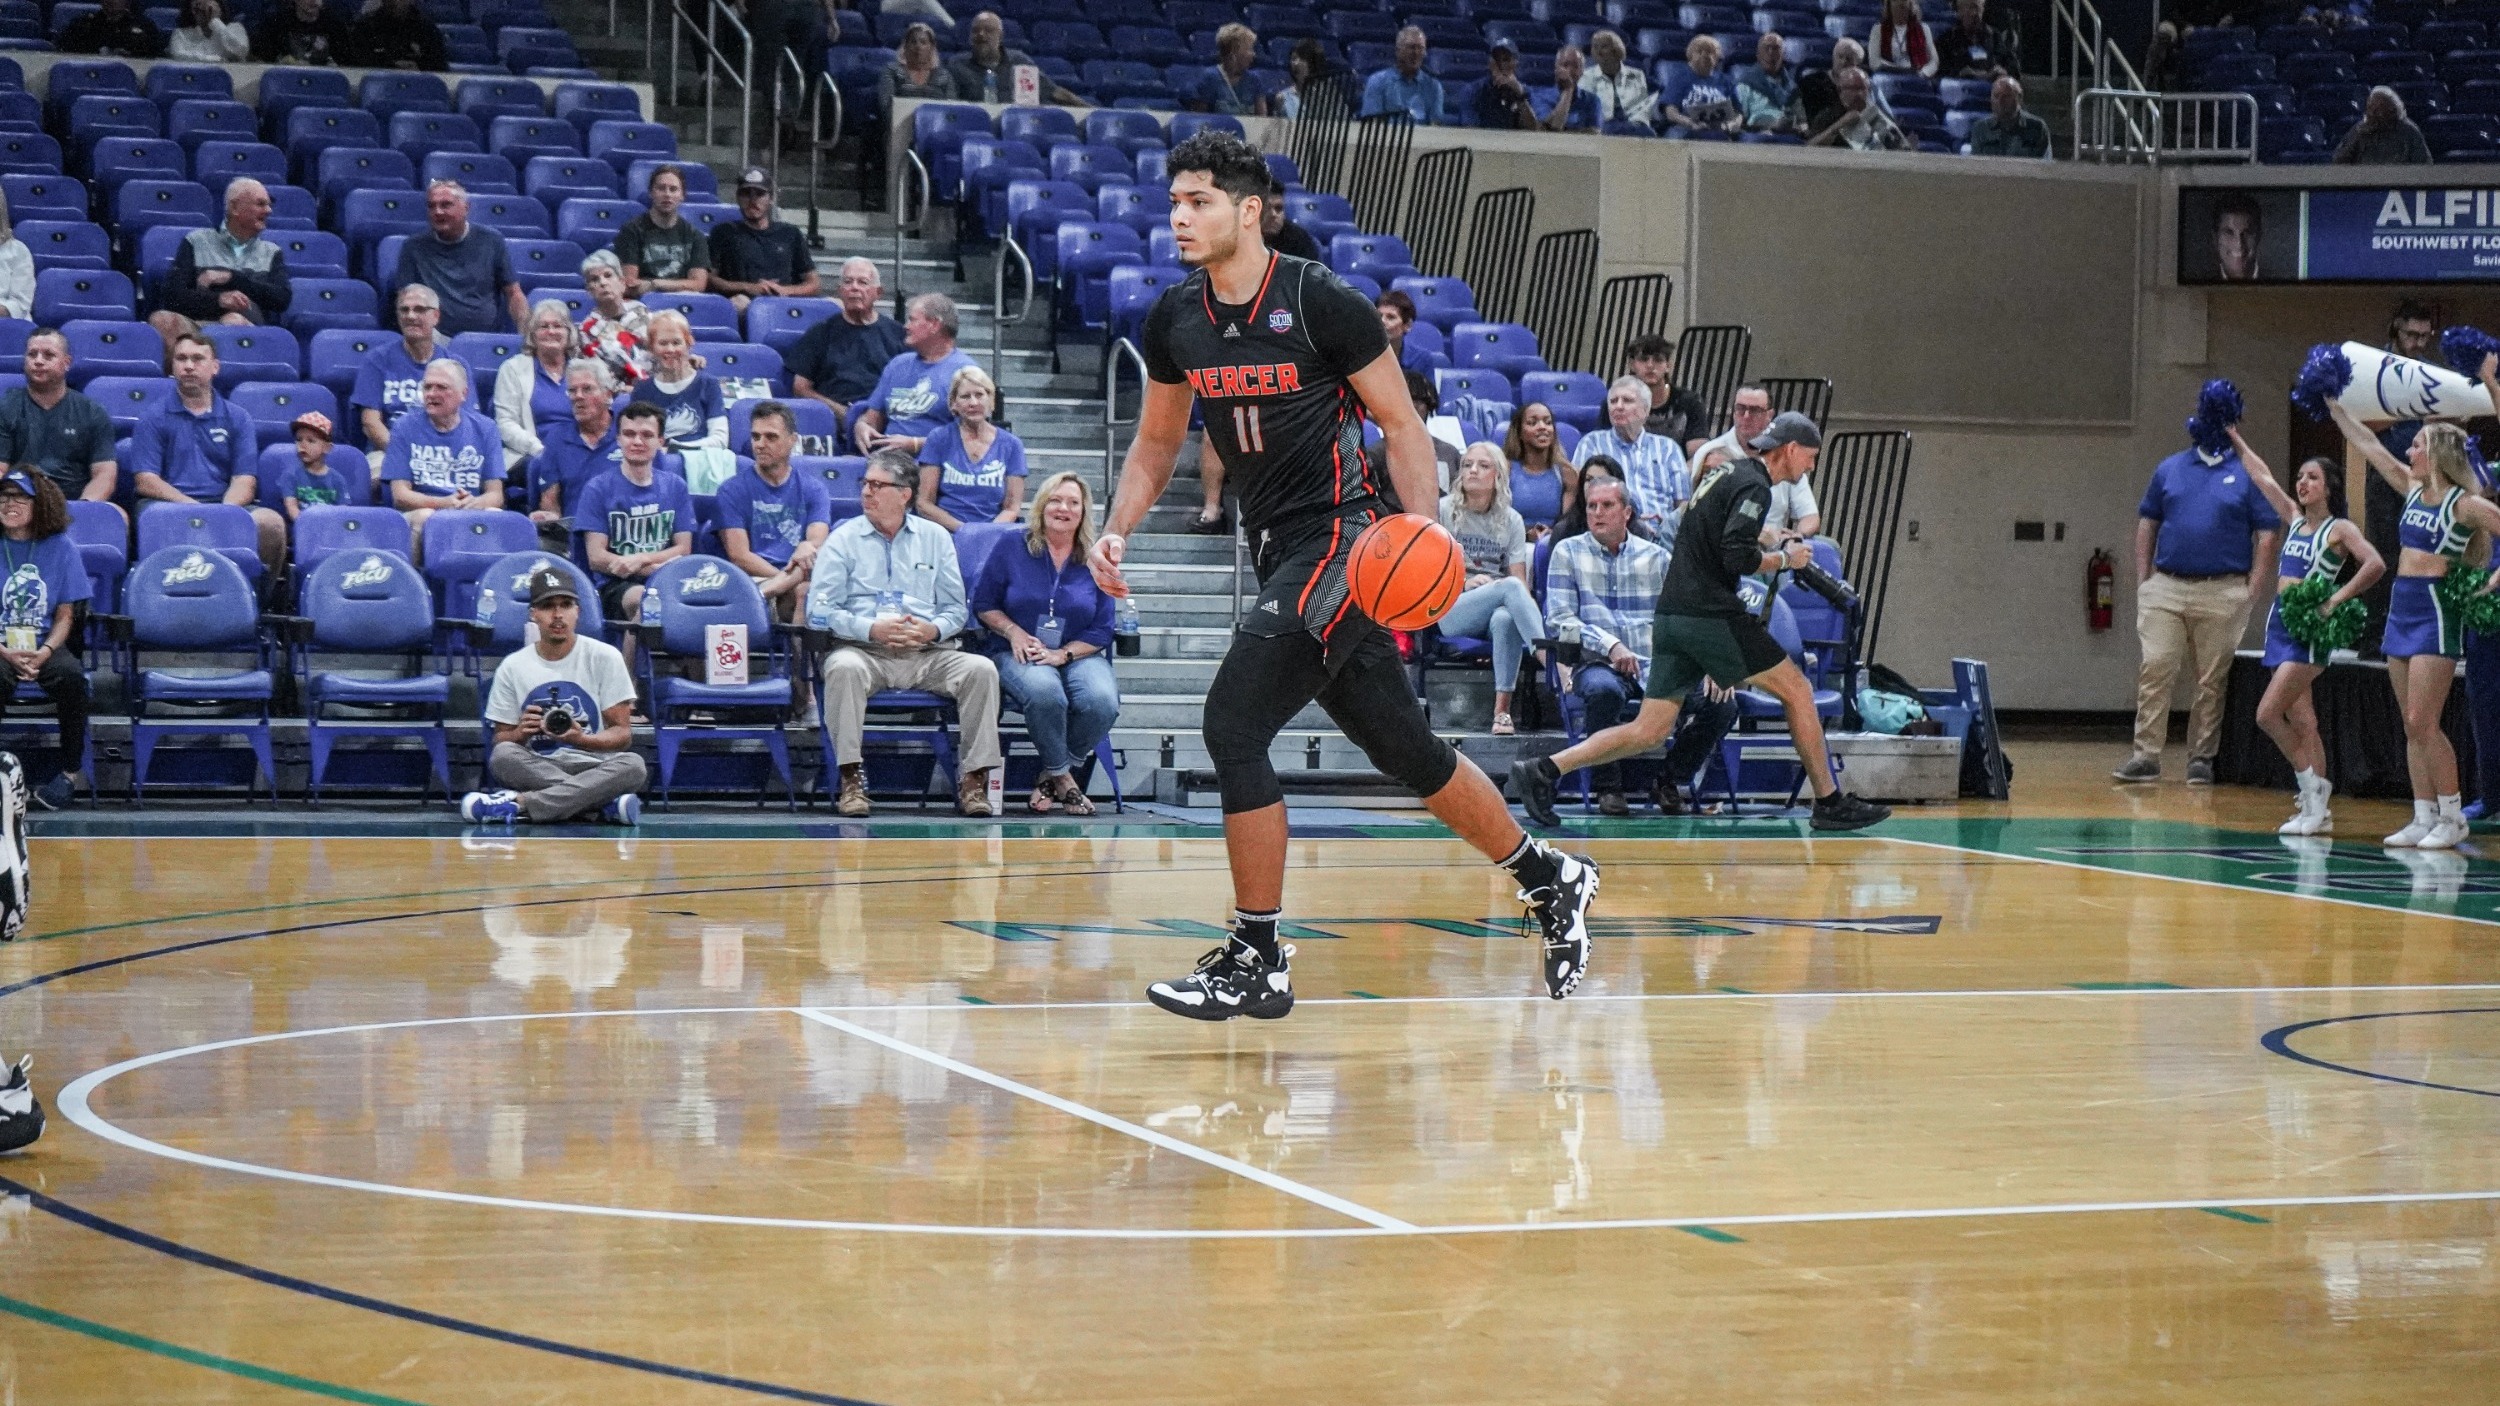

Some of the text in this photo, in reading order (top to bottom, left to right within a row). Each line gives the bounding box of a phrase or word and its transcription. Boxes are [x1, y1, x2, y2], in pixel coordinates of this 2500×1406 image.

[2372, 235, 2469, 250] SOUTHWEST
[2473, 254, 2500, 267] Savi
[1269, 313, 1293, 328] SOCON
[1184, 362, 1302, 398] MERCER
[383, 379, 424, 405] FG
[1232, 405, 1264, 453] 11
[411, 443, 454, 461] HAIL
[412, 470, 481, 488] EAGLES
[609, 509, 675, 549] DUNK
[163, 563, 214, 586] FGCU
[341, 566, 392, 589] FGCU
[511, 574, 532, 590] FG
[545, 572, 560, 587] LA
[680, 573, 729, 595] FGCU
[716, 642, 735, 655] POP
[720, 651, 742, 666] CORN
